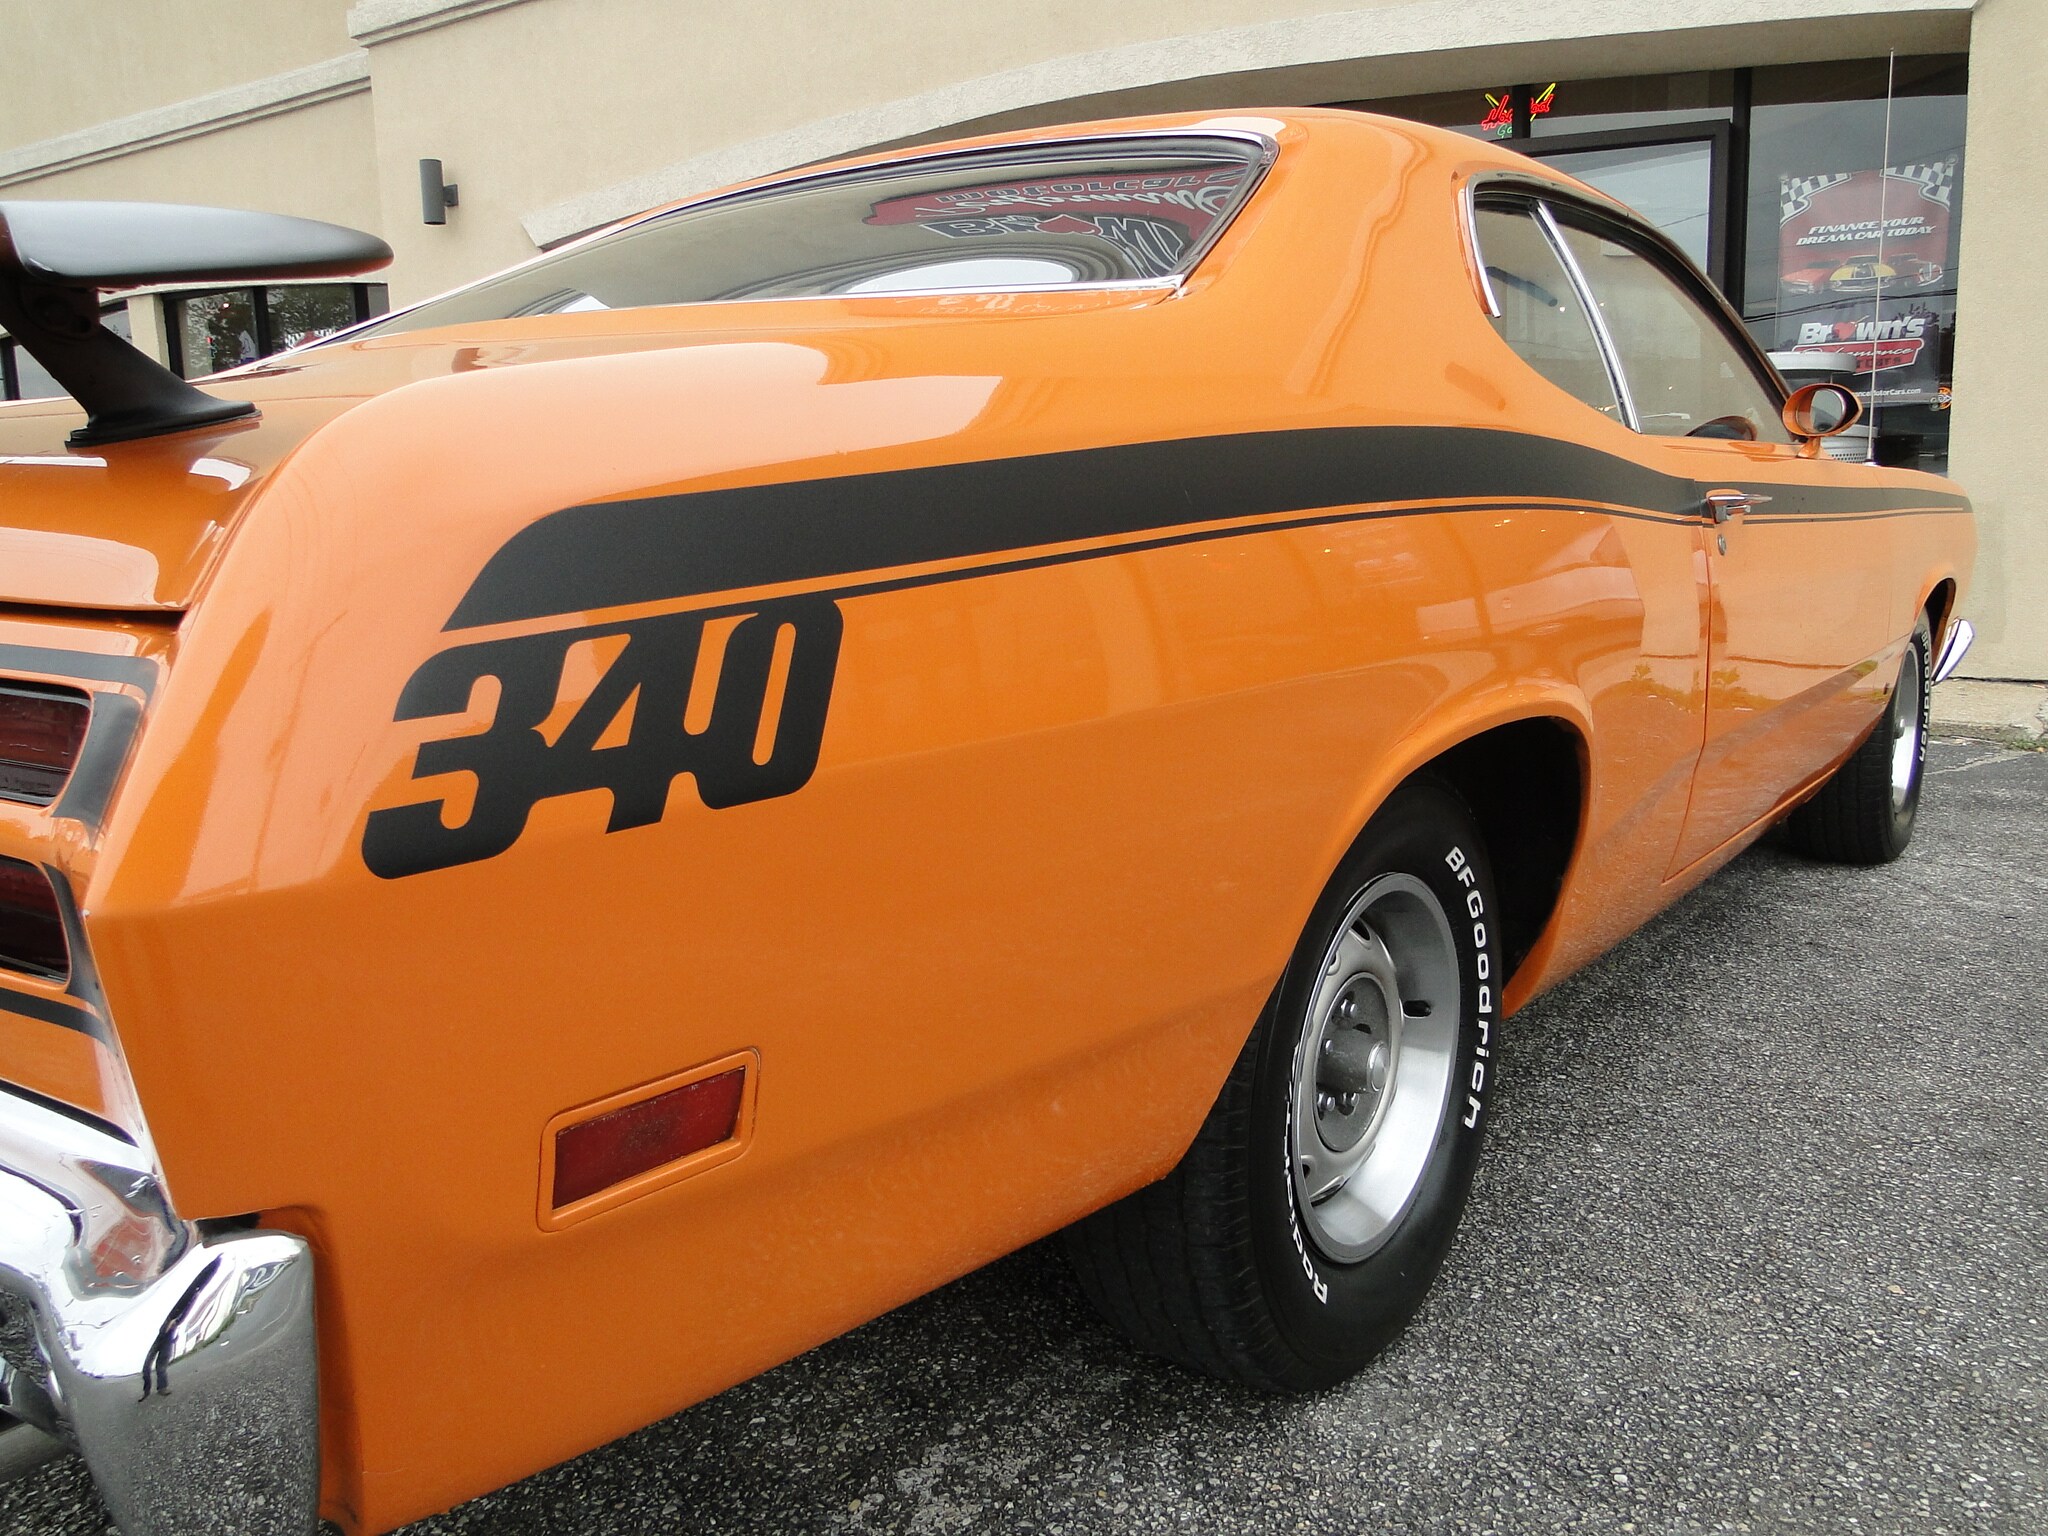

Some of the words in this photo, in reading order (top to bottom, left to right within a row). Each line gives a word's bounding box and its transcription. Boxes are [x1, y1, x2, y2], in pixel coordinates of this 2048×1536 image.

[1796, 233, 1854, 246] DREAM
[1887, 225, 1936, 238] TODAY
[1808, 220, 1880, 234] FINANCE
[1882, 216, 1925, 229] YOUR
[361, 597, 844, 880] 340
[1444, 845, 1493, 1129] BFGoodrich
